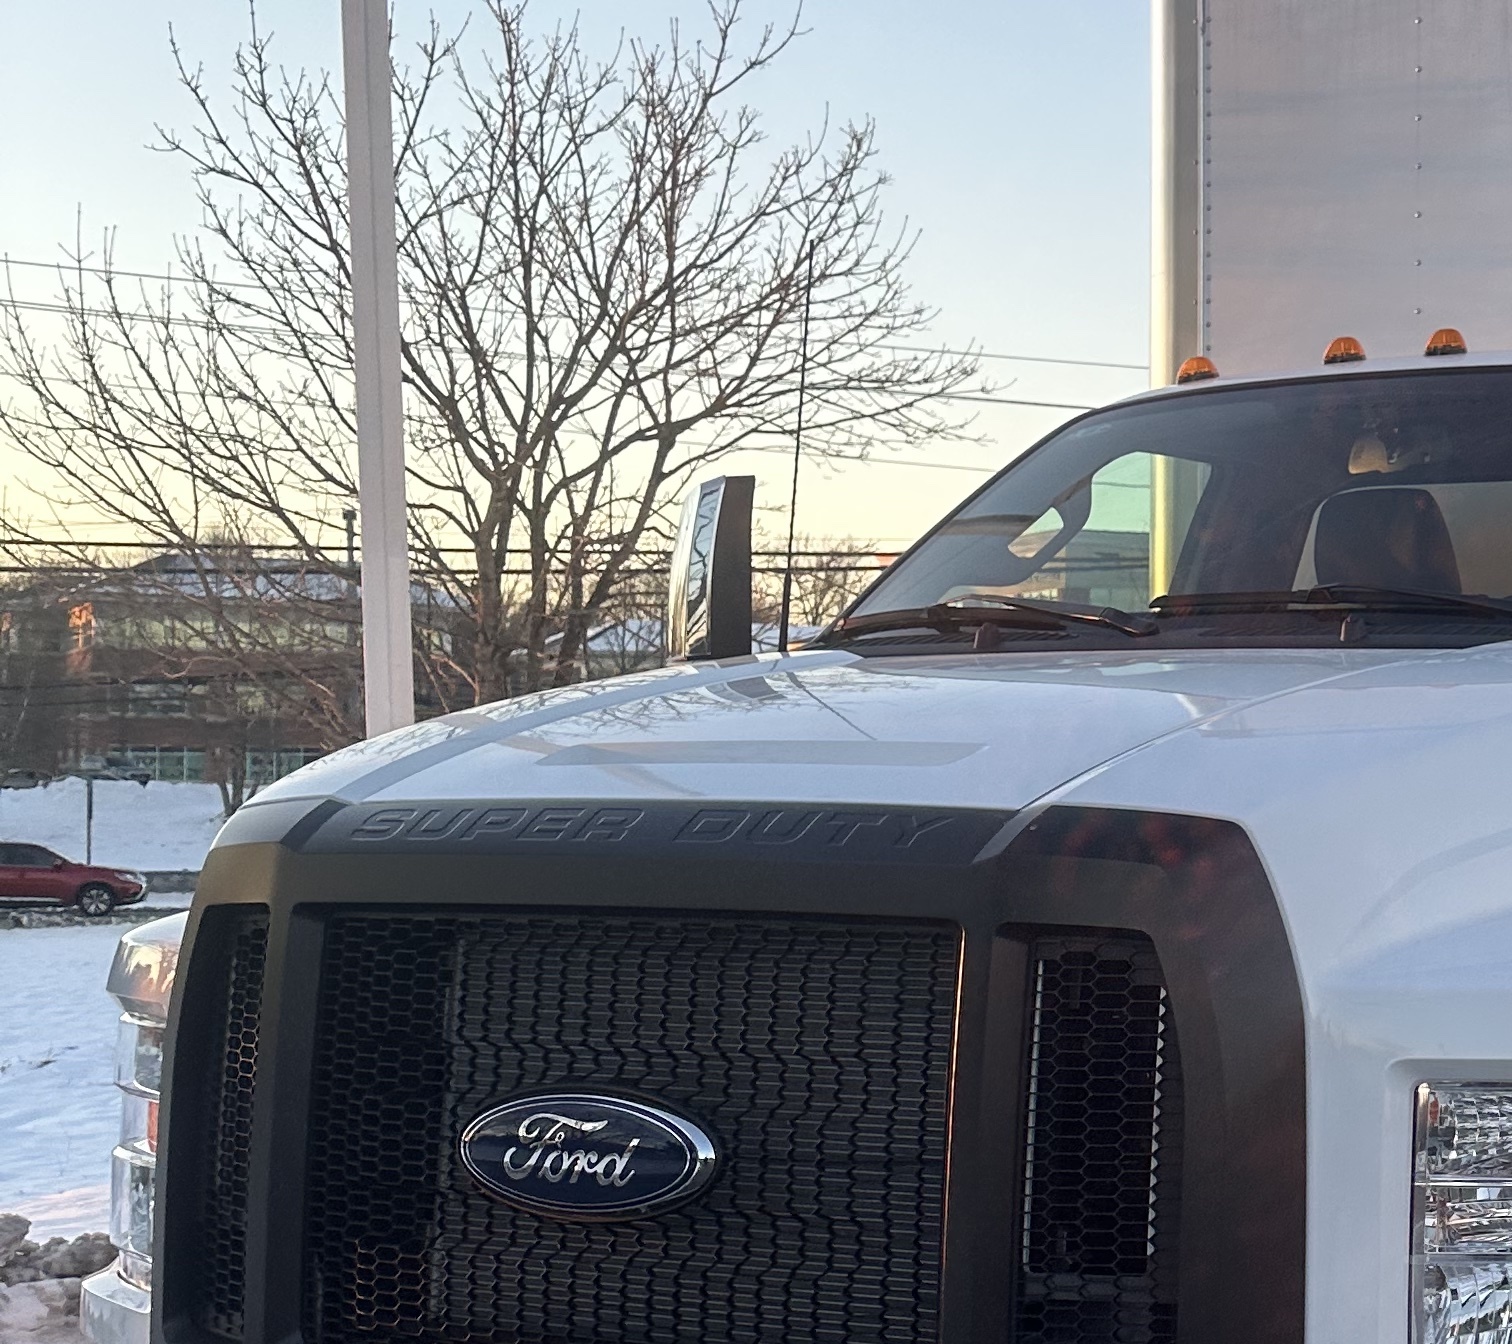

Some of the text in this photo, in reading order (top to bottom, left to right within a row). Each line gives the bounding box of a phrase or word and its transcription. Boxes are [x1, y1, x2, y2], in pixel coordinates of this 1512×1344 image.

[350, 807, 956, 848] SUPER DUTY
[503, 1113, 641, 1188] Ford
